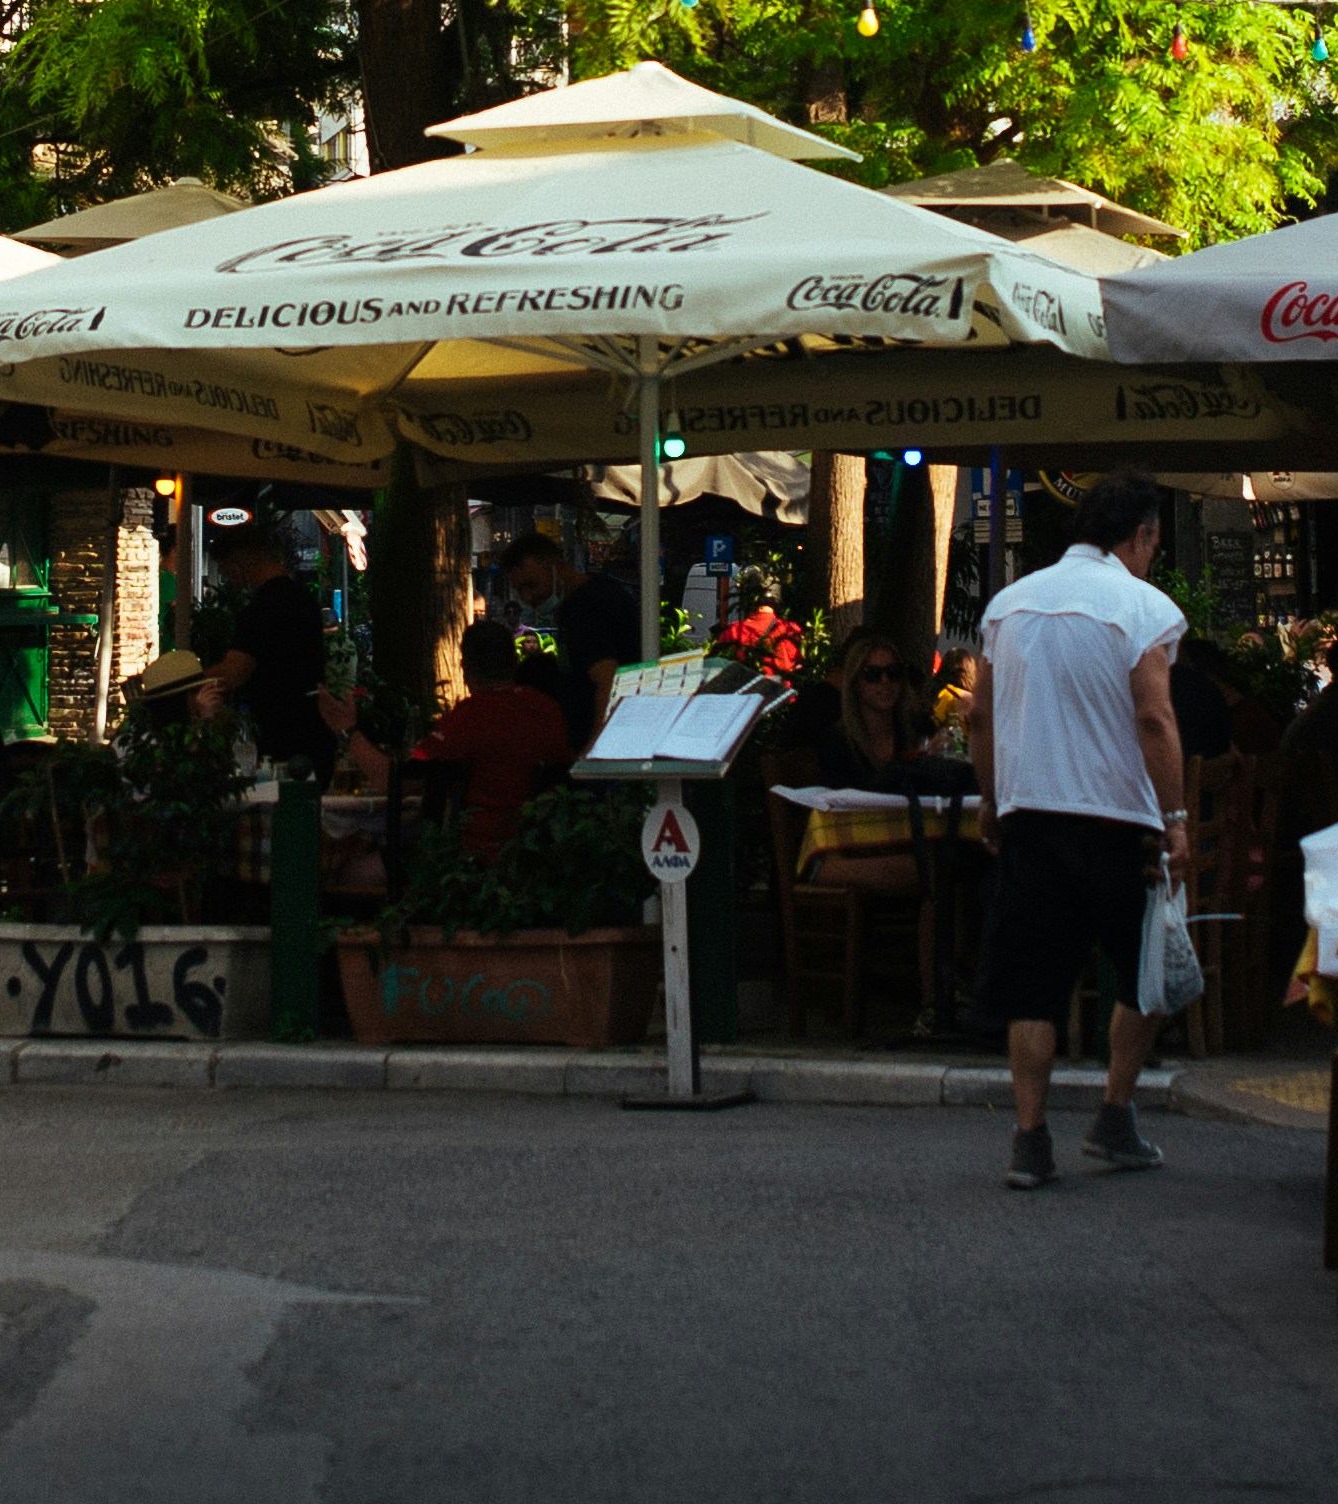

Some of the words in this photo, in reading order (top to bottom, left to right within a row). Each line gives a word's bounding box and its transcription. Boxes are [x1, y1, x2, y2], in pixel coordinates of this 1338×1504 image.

[215, 210, 771, 273] Coca-Cola
[184, 297, 383, 329] DELICIOUS
[388, 299, 440, 318] AND
[446, 283, 685, 317] REFRESHING
[787, 273, 949, 318] Coca-Cola
[712, 539, 727, 558] P
